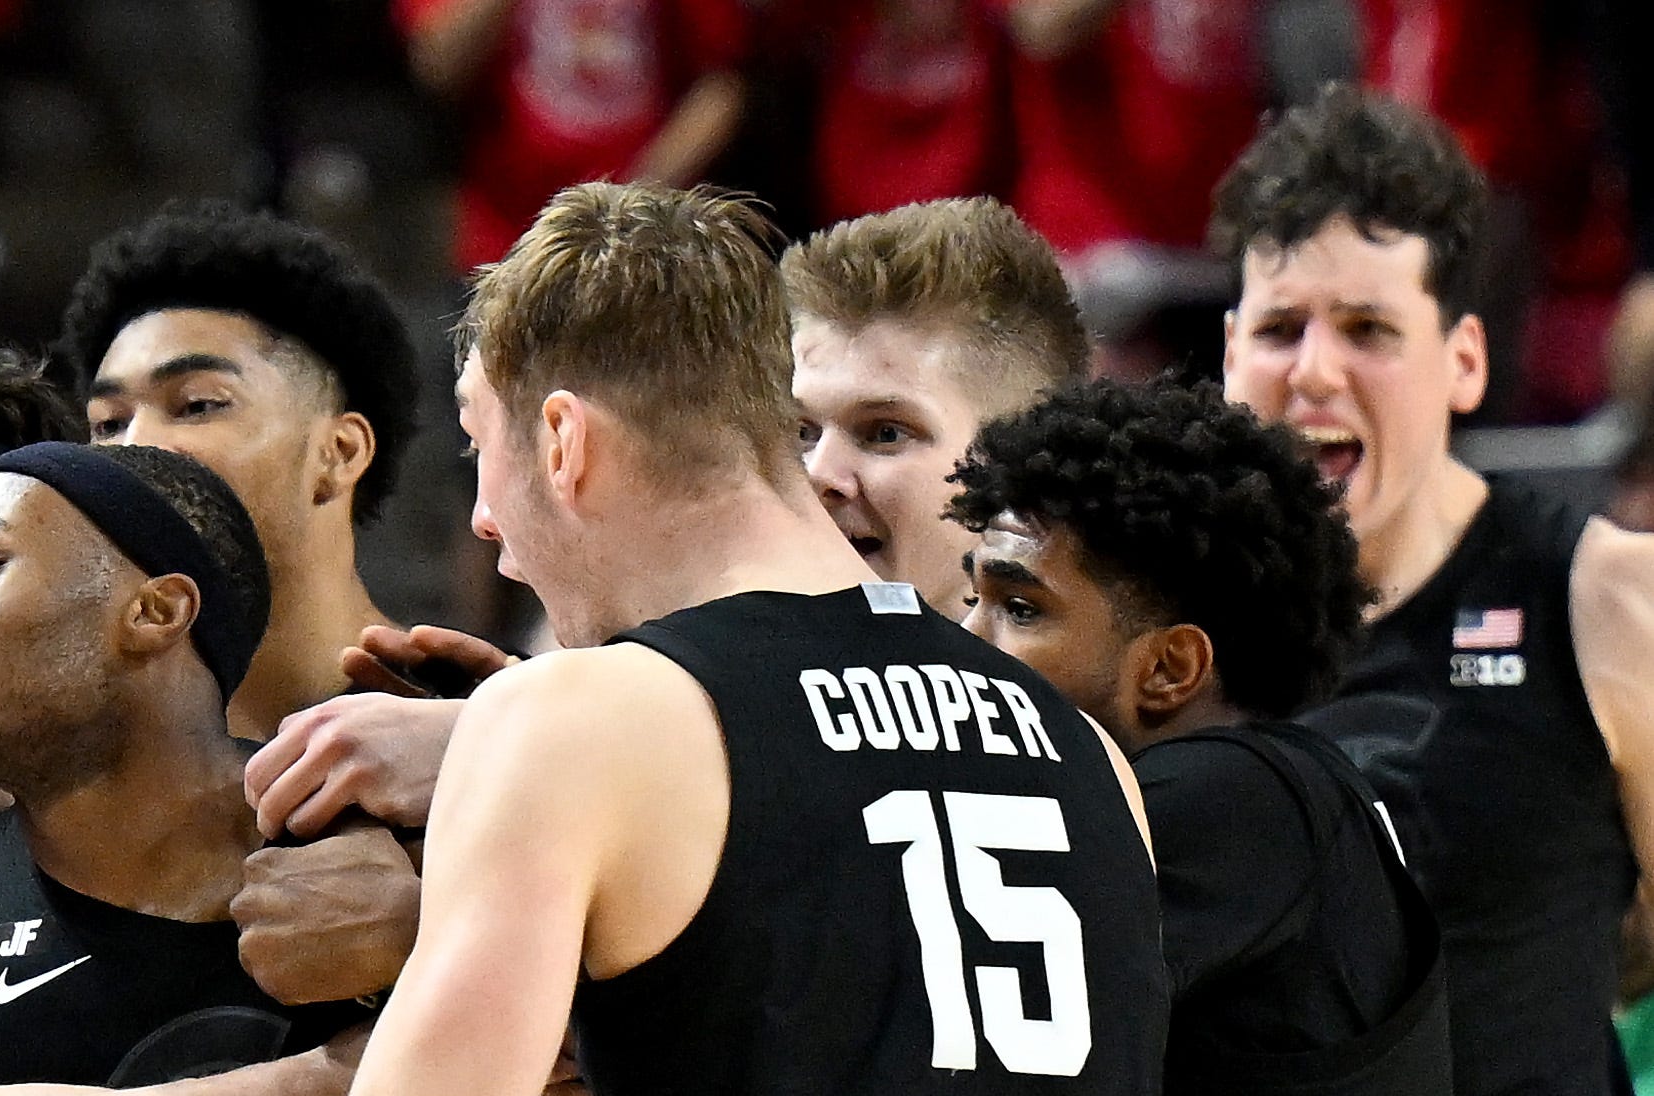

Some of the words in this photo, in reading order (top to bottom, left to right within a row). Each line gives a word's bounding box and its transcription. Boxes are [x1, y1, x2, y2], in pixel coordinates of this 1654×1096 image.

[799, 664, 1061, 762] COOPER
[0, 919, 42, 956] JF
[862, 791, 1091, 1076] 15
